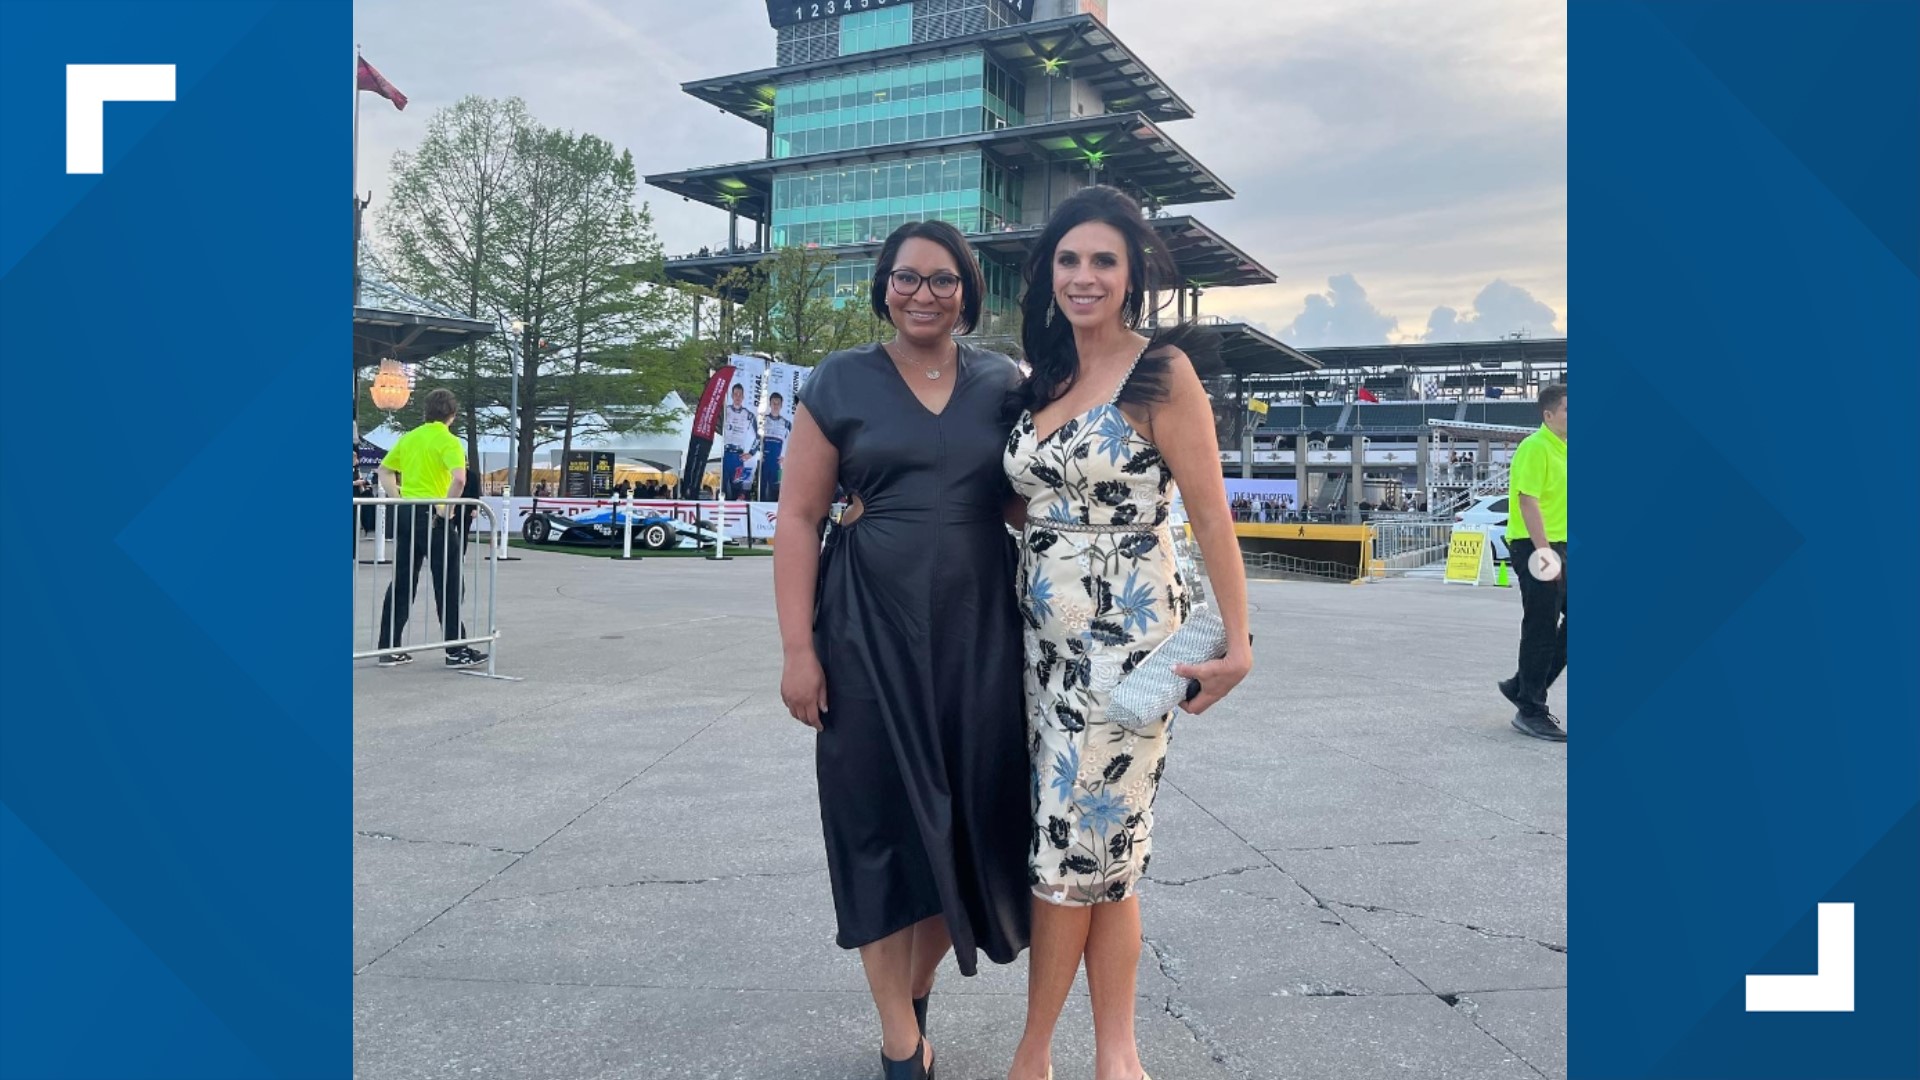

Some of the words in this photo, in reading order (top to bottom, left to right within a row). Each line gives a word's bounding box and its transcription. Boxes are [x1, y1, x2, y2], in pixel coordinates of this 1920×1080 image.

[811, 3, 819, 17] 2
[827, 0, 836, 14] 3
[1453, 540, 1480, 548] VALET
[1453, 546, 1477, 555] ONLY
